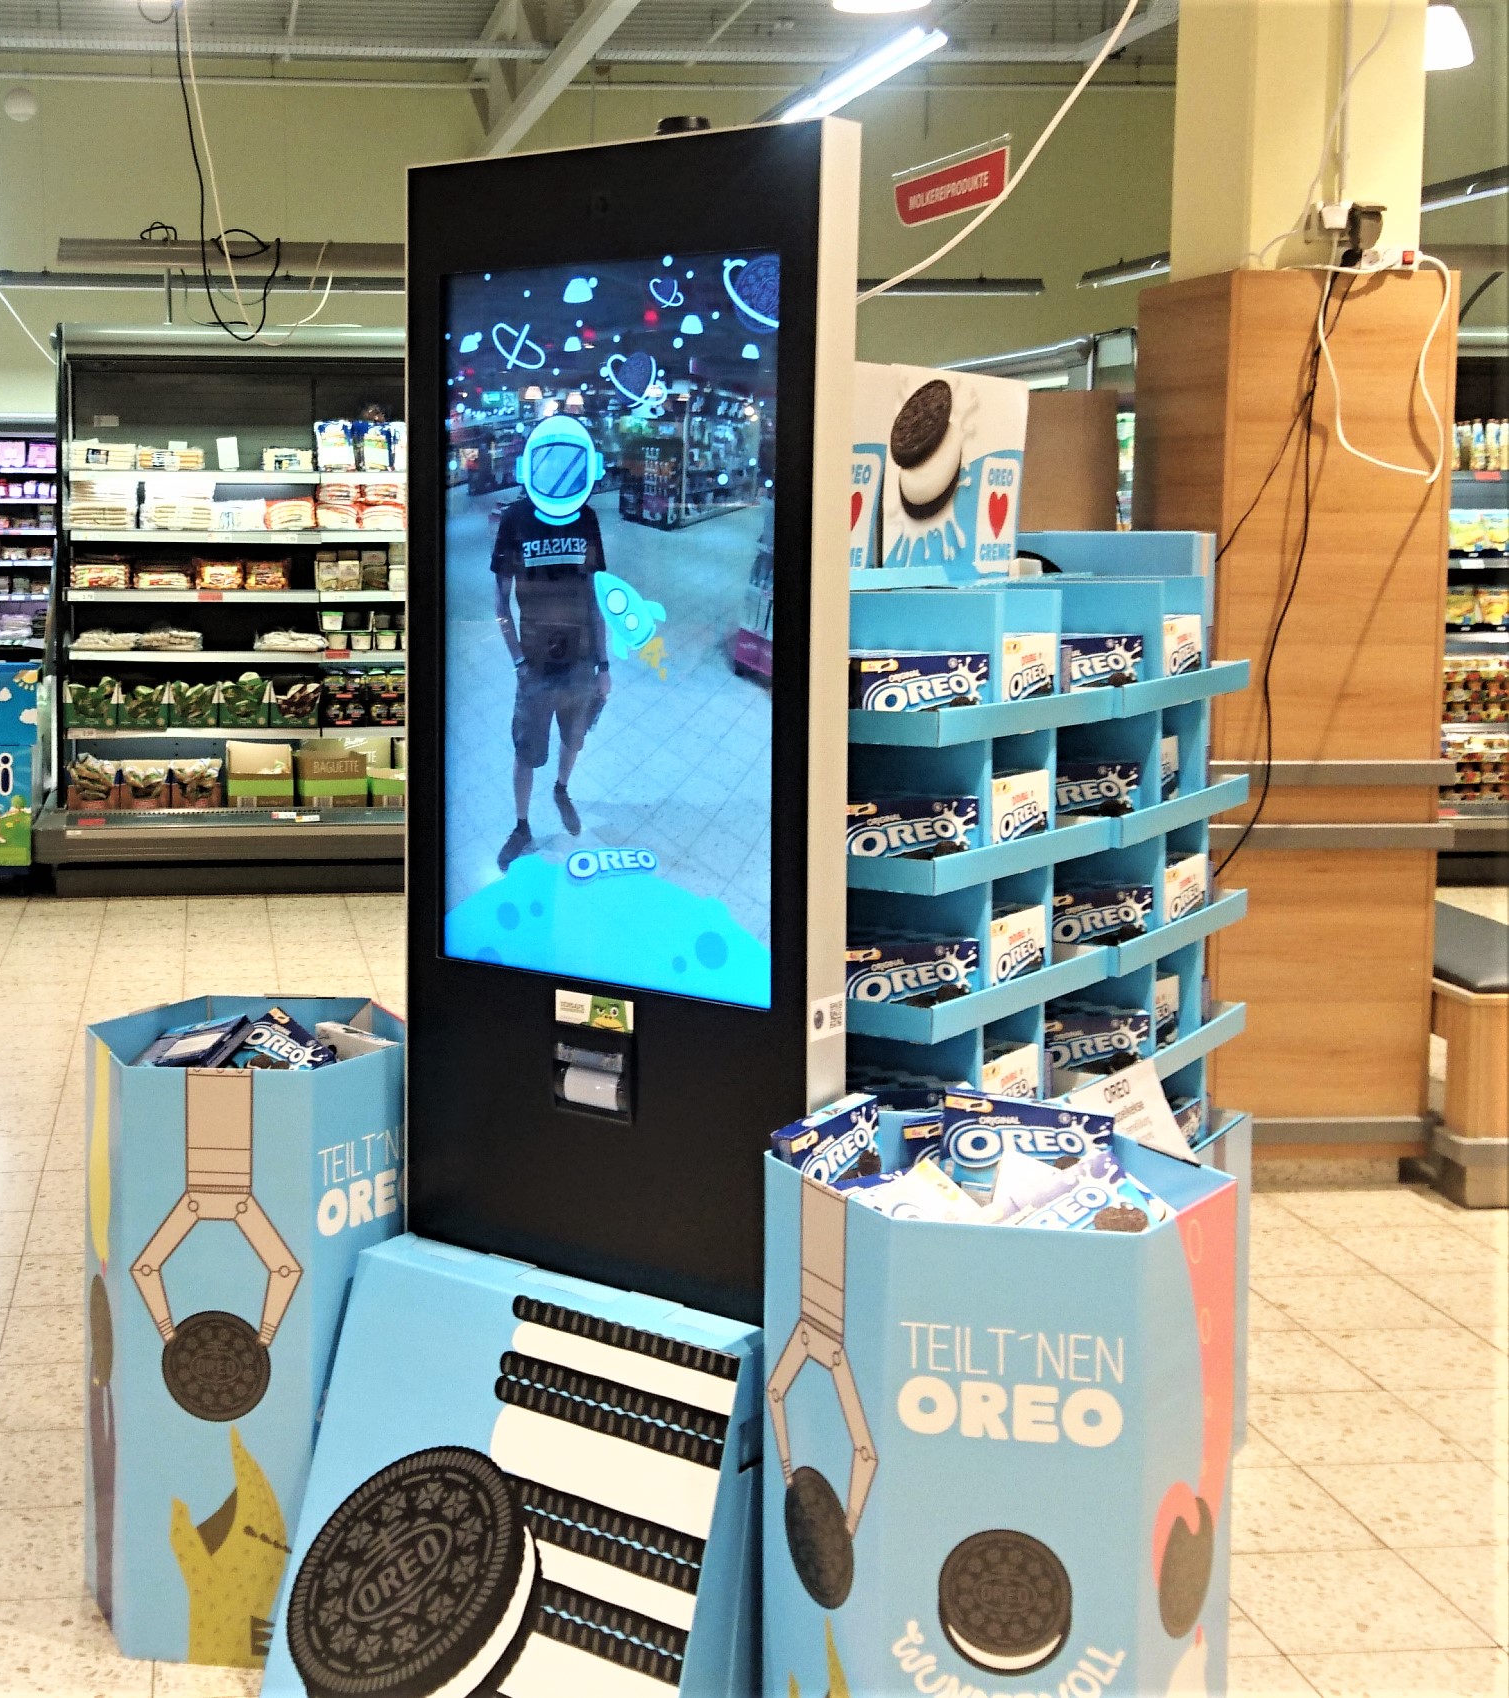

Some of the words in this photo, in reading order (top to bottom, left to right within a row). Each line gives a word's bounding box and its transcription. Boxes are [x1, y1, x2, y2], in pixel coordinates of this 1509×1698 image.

[909, 171, 989, 210] MOLKEREIPRODUKTE
[988, 467, 1013, 487] OREO
[1009, 664, 1050, 699] OREO
[1071, 652, 1127, 680] REO
[873, 674, 969, 711] OREO
[313, 760, 359, 774] BAGUETTE
[1058, 780, 1120, 806] REO
[851, 818, 957, 858] OREO
[1000, 801, 1039, 839] OREO
[568, 850, 657, 878] OREO
[1053, 905, 1137, 943] OREO
[997, 939, 1036, 981] OREO
[855, 963, 960, 1003] OREO
[244, 1028, 305, 1062] OREO
[1104, 1079, 1130, 1103] OREO
[979, 1116, 1020, 1126] ORIGINAL
[806, 1128, 870, 1183] OREO
[957, 1129, 1085, 1160] OREO
[317, 1168, 403, 1236] ORE
[897, 1375, 1123, 1448] OREO
[358, 1533, 441, 1613] OREO
